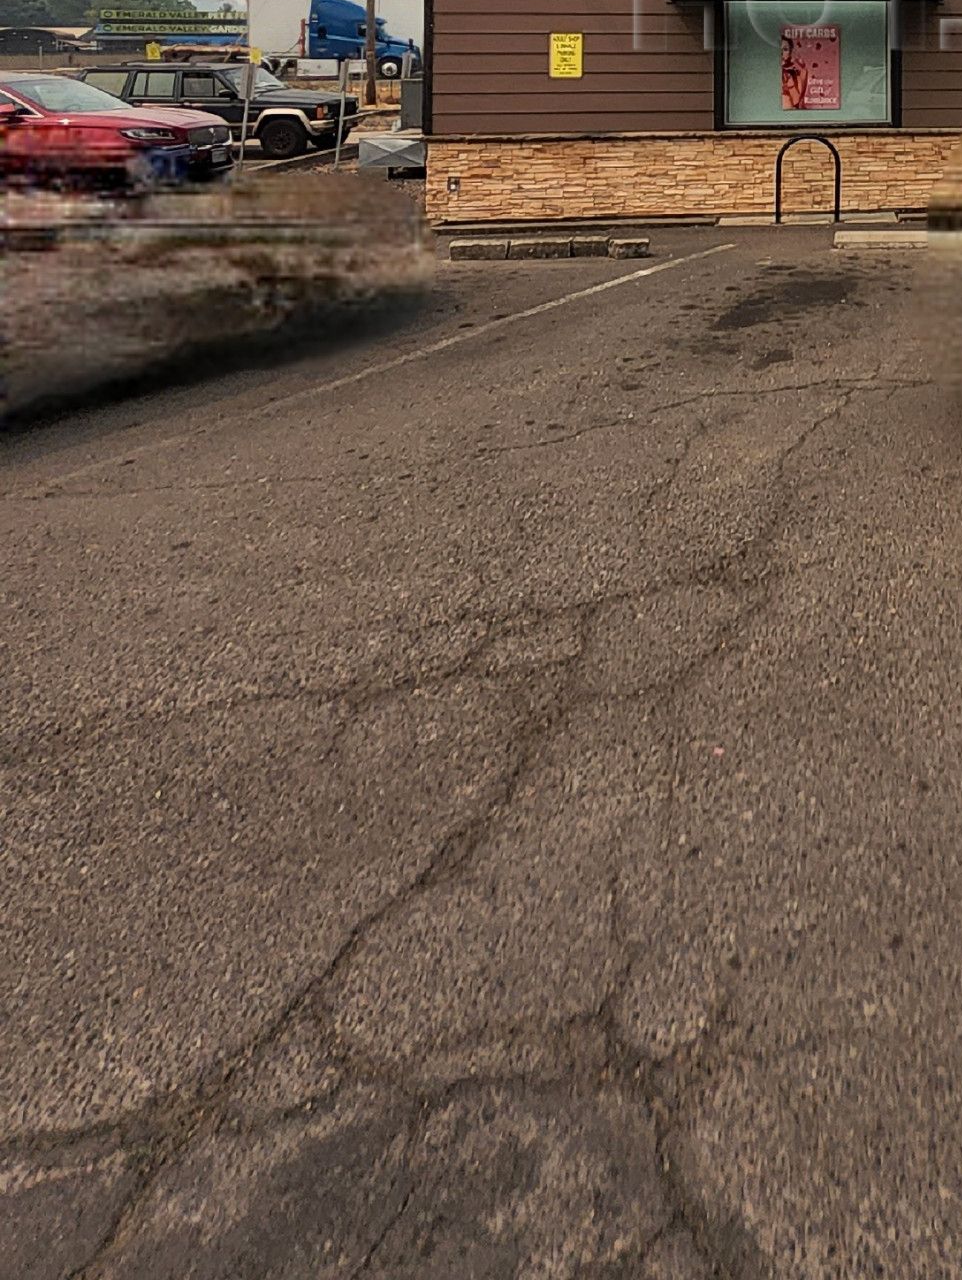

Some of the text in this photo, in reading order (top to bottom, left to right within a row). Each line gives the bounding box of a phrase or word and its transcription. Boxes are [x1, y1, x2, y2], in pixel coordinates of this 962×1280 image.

[115, 11, 167, 19] EMERALD
[168, 11, 209, 19] VALLEY
[115, 25, 166, 33] EMERALD
[168, 25, 209, 33] VALLEY
[784, 28, 836, 39] GIFT CARDS
